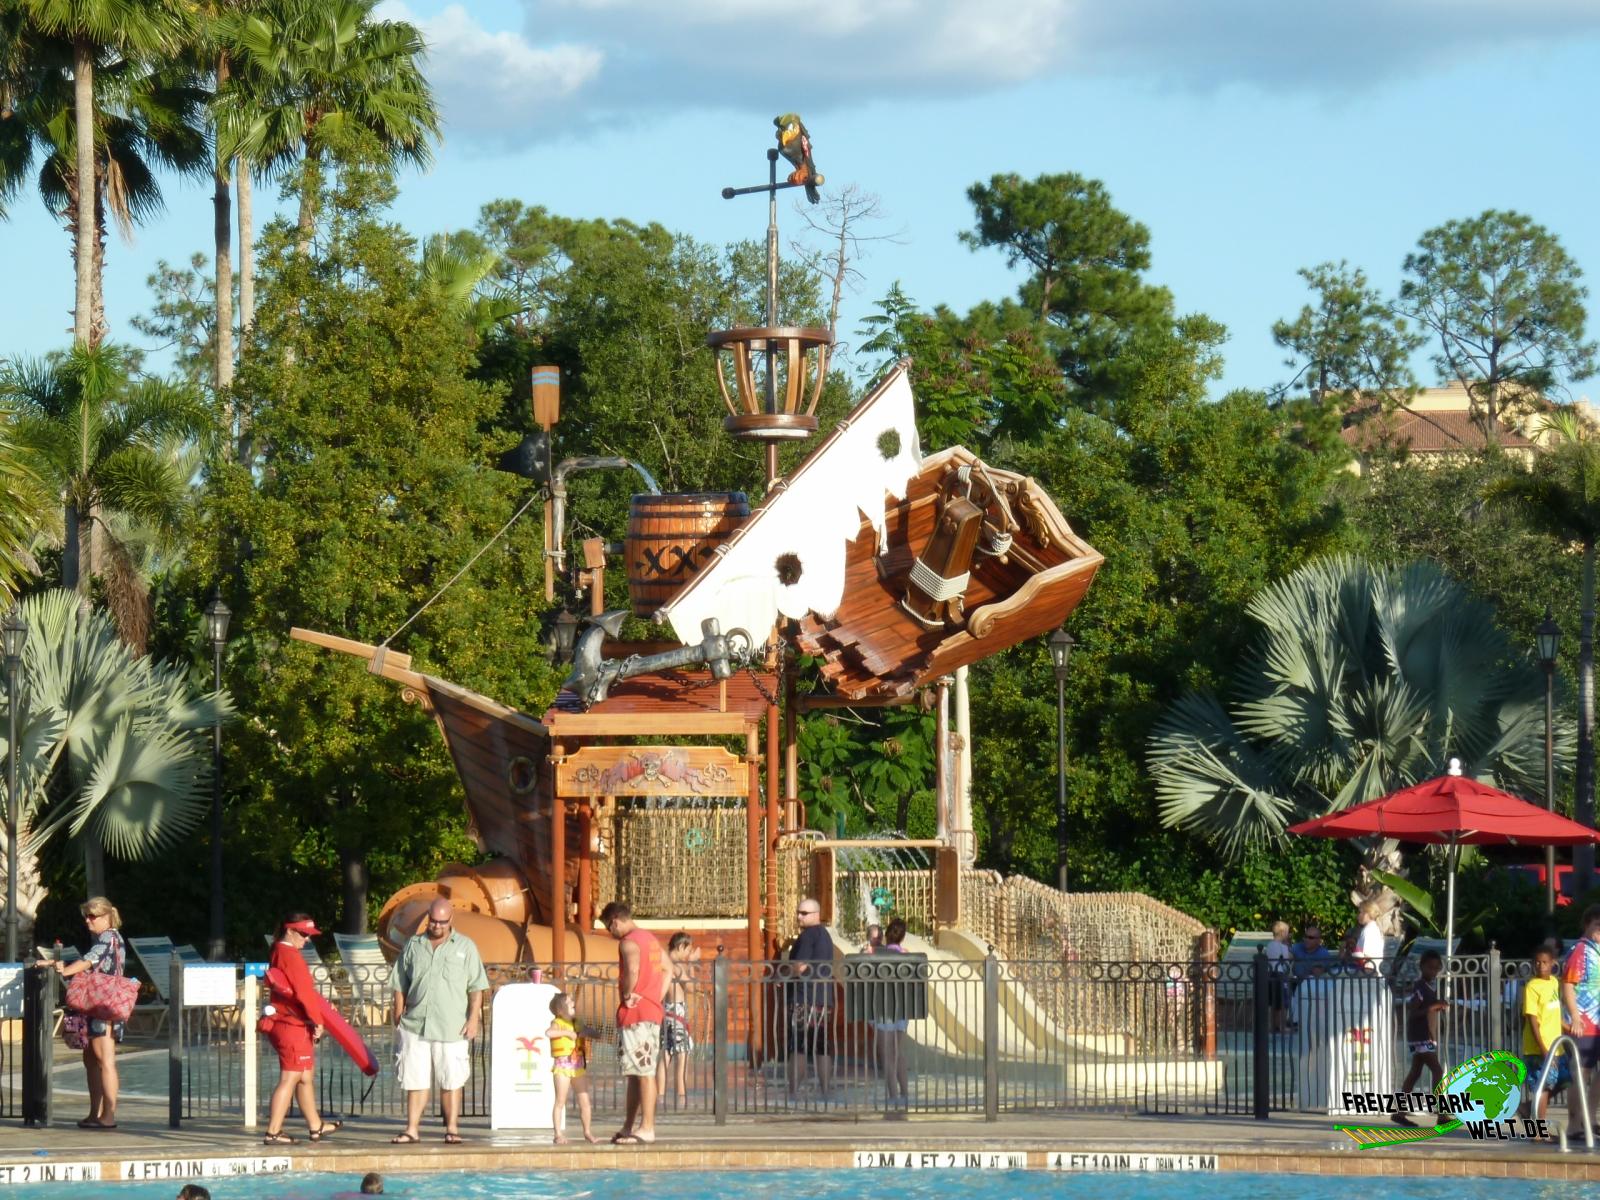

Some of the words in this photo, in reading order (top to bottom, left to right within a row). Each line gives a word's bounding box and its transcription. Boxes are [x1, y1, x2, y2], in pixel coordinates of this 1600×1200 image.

[921, 1153, 939, 1168] FT
[947, 1153, 957, 1168] 2
[965, 1153, 982, 1168] IN
[990, 1155, 1000, 1169] AT
[1138, 1156, 1149, 1169] AT
[23, 1166, 31, 1182] 2
[40, 1164, 56, 1181] IN
[64, 1166, 74, 1181] AT
[143, 1162, 161, 1179] FT
[187, 1161, 204, 1176] IN
